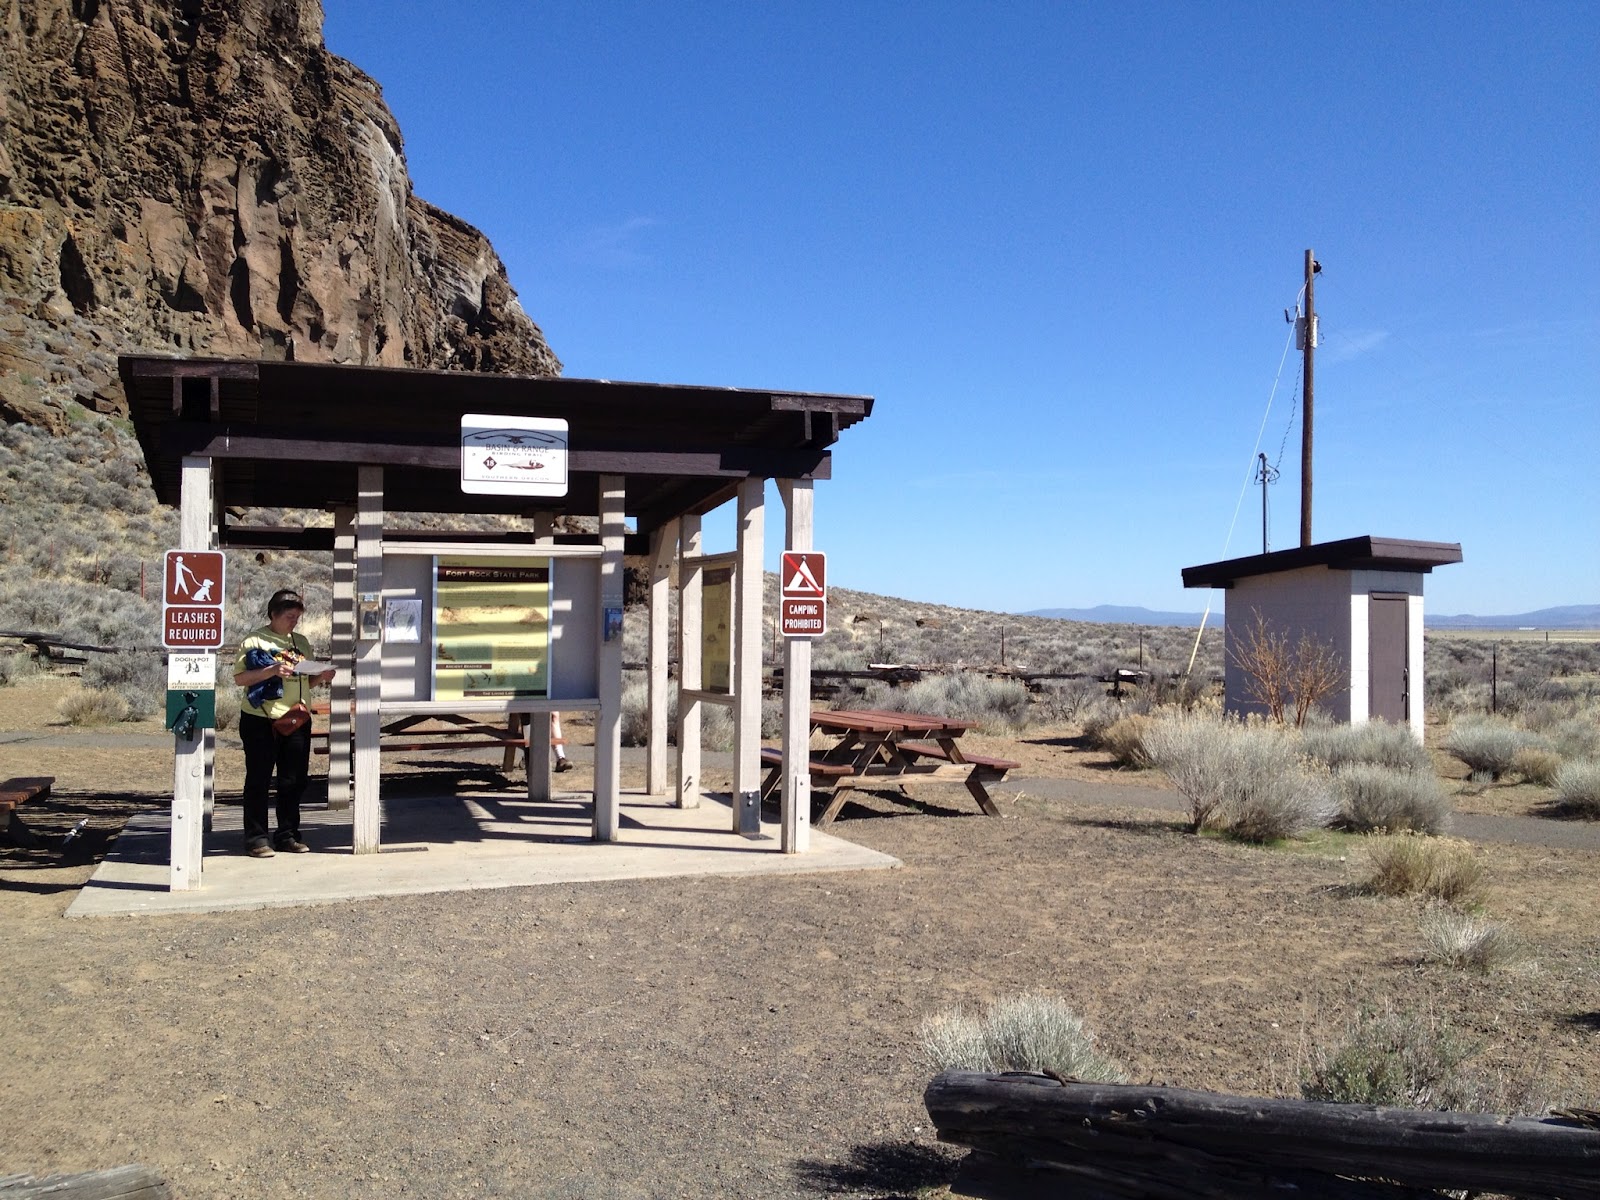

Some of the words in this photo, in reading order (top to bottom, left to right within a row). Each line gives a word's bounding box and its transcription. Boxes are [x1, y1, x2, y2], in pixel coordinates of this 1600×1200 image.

[486, 443, 510, 452] BASIN
[521, 445, 549, 454] RANGE
[789, 604, 818, 614] CAMPING
[171, 612, 216, 624] LEASHES
[784, 618, 822, 628] PROHIBITED
[169, 628, 217, 640] REQUIRED
